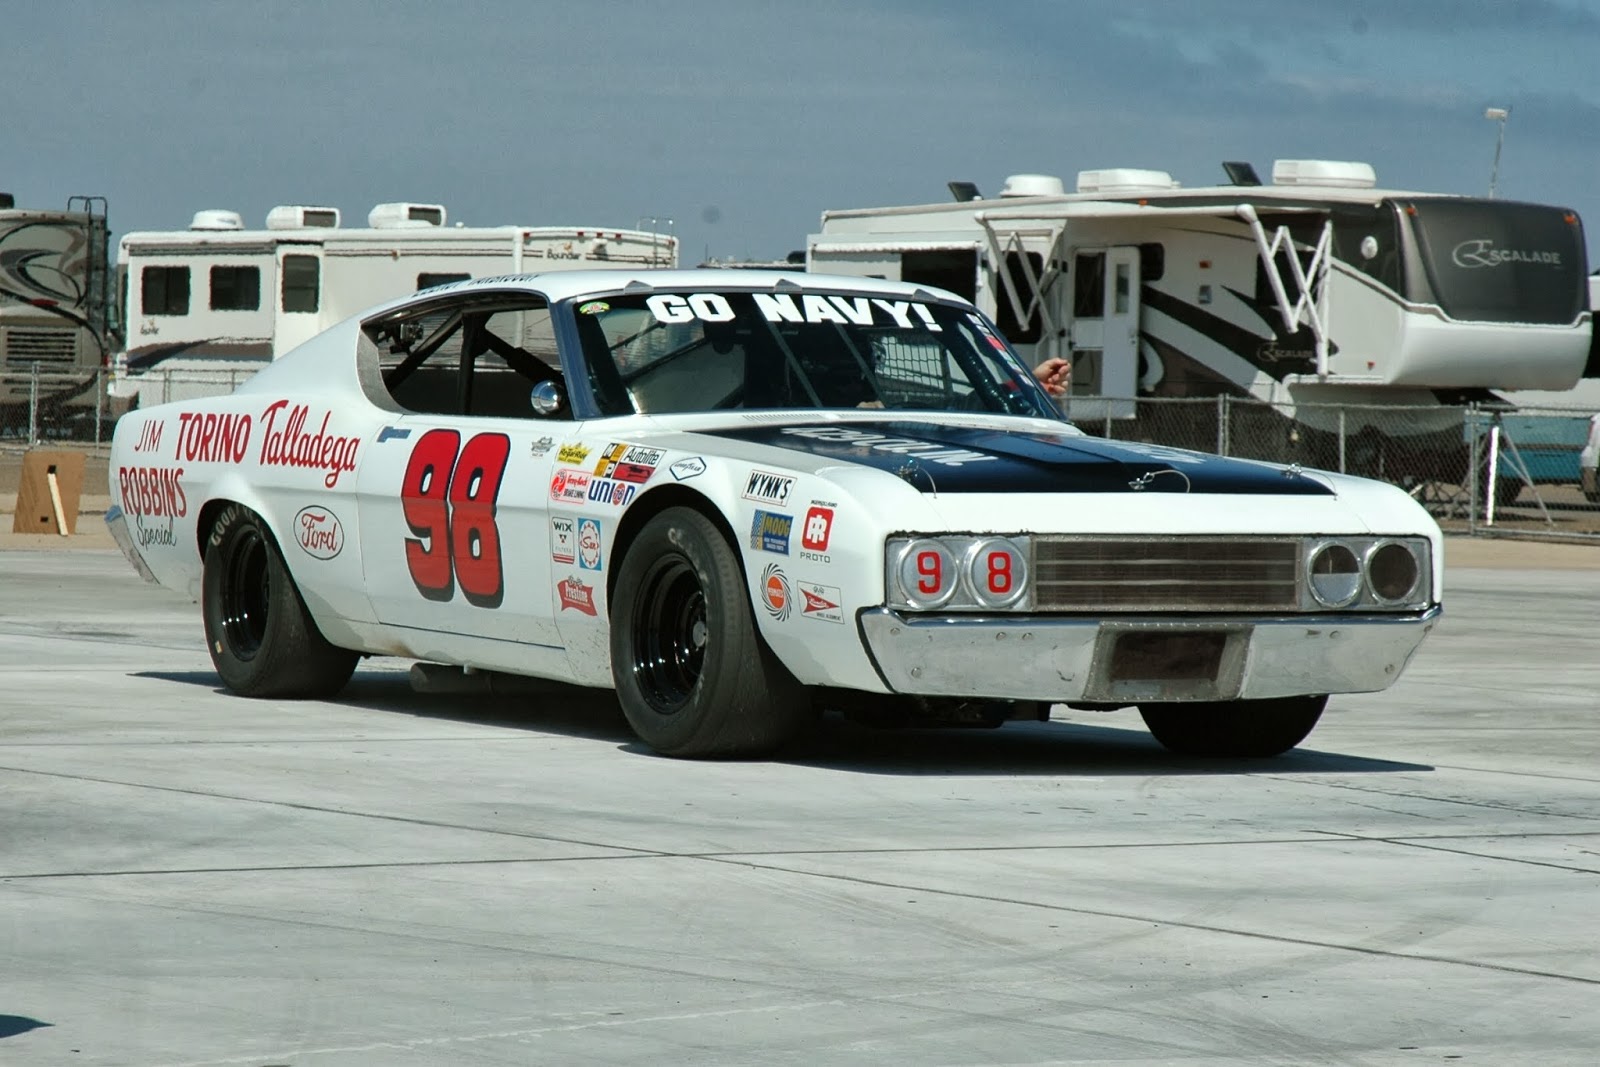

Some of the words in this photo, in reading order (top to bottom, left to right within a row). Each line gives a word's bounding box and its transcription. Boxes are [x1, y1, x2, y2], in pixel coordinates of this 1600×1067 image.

[1452, 239, 1561, 268] ESCALADE
[646, 293, 736, 324] GO
[752, 293, 943, 332] NAVY!
[134, 420, 165, 452] JIM
[175, 413, 252, 464] TORINO
[260, 399, 361, 488] Talladega
[624, 447, 660, 466] Autolite
[119, 466, 187, 518] ROBBINS
[588, 479, 636, 506] UNION
[747, 472, 792, 500] WYNN'S
[136, 512, 178, 549] Special
[301, 513, 338, 551] Ford
[401, 428, 510, 609] 98
[553, 521, 572, 532] WIX
[763, 516, 790, 538] MOOG
[800, 551, 831, 564] PROTO
[917, 551, 941, 594] 9
[988, 551, 1012, 594] 8
